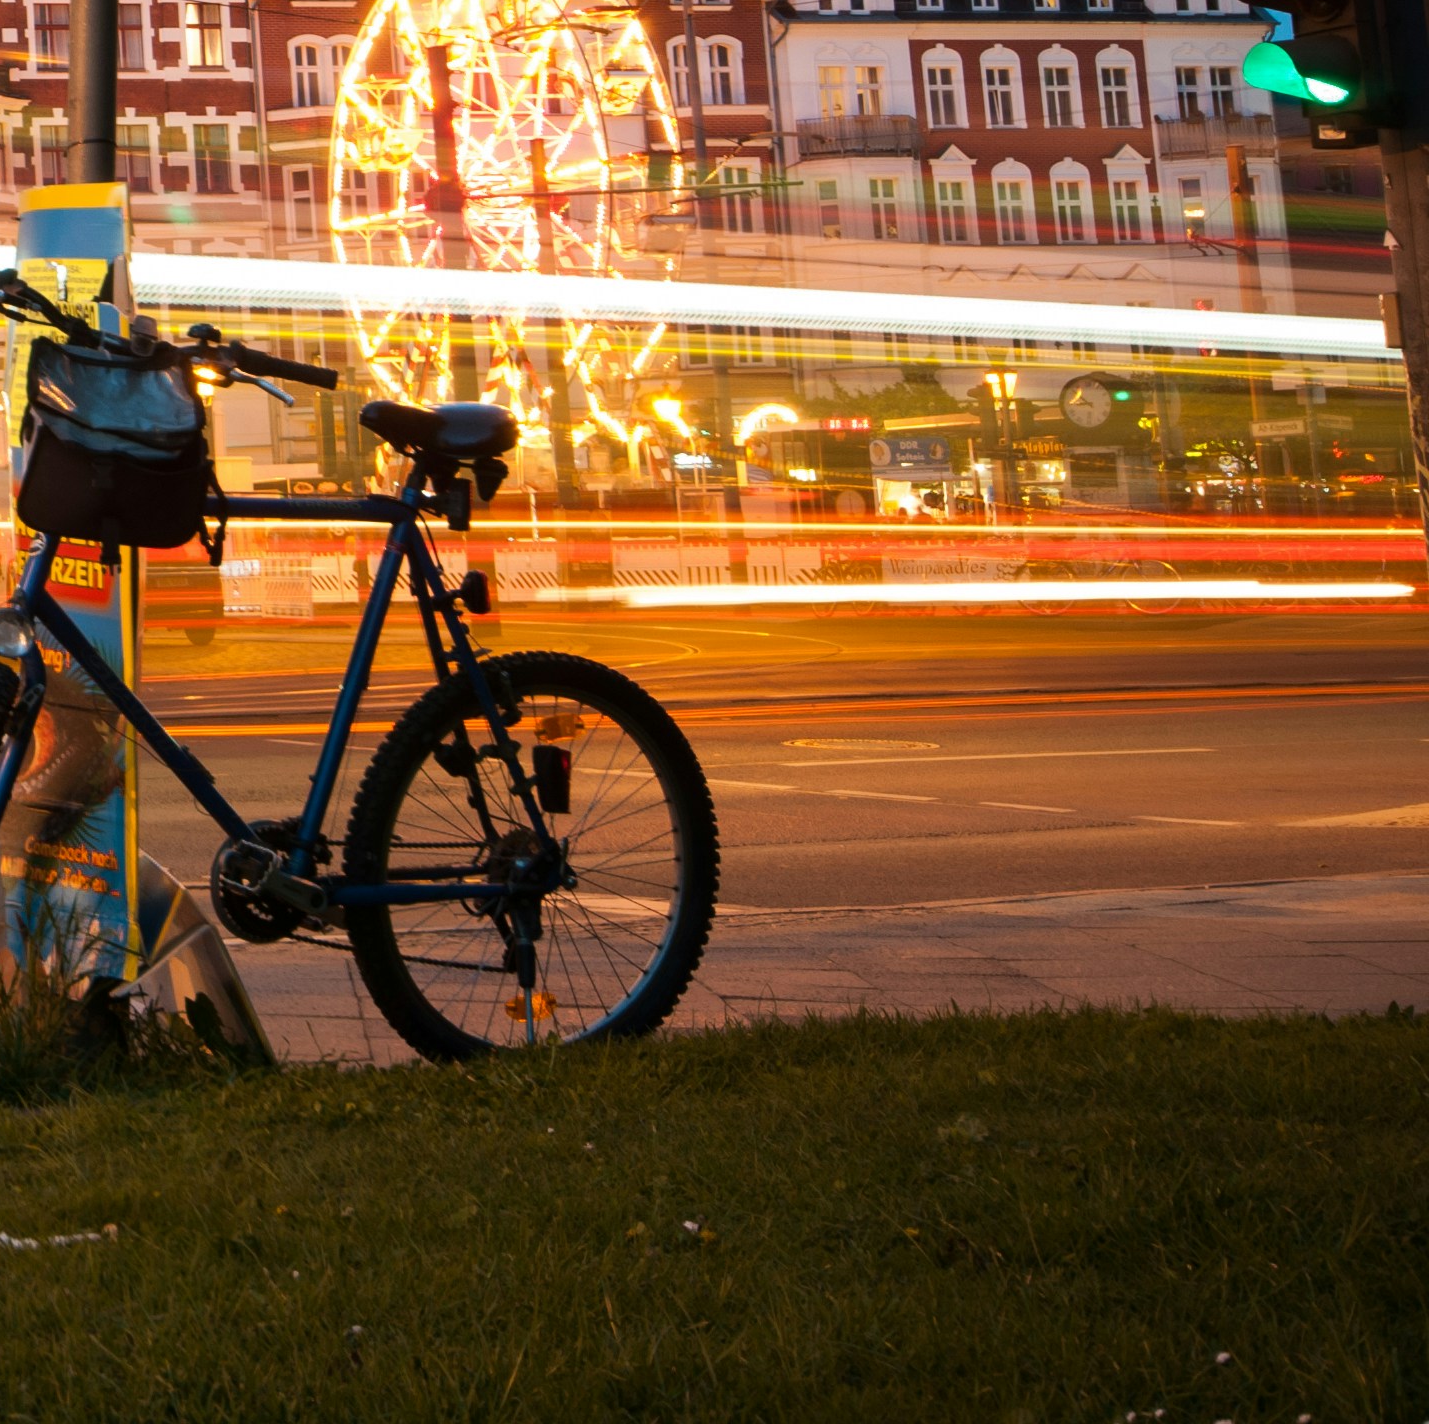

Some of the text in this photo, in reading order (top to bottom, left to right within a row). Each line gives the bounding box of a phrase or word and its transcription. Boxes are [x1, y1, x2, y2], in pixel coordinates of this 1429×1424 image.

[899, 440, 919, 449] DDR
[895, 452, 925, 462] Softeis
[25, 835, 89, 864] Comeback
